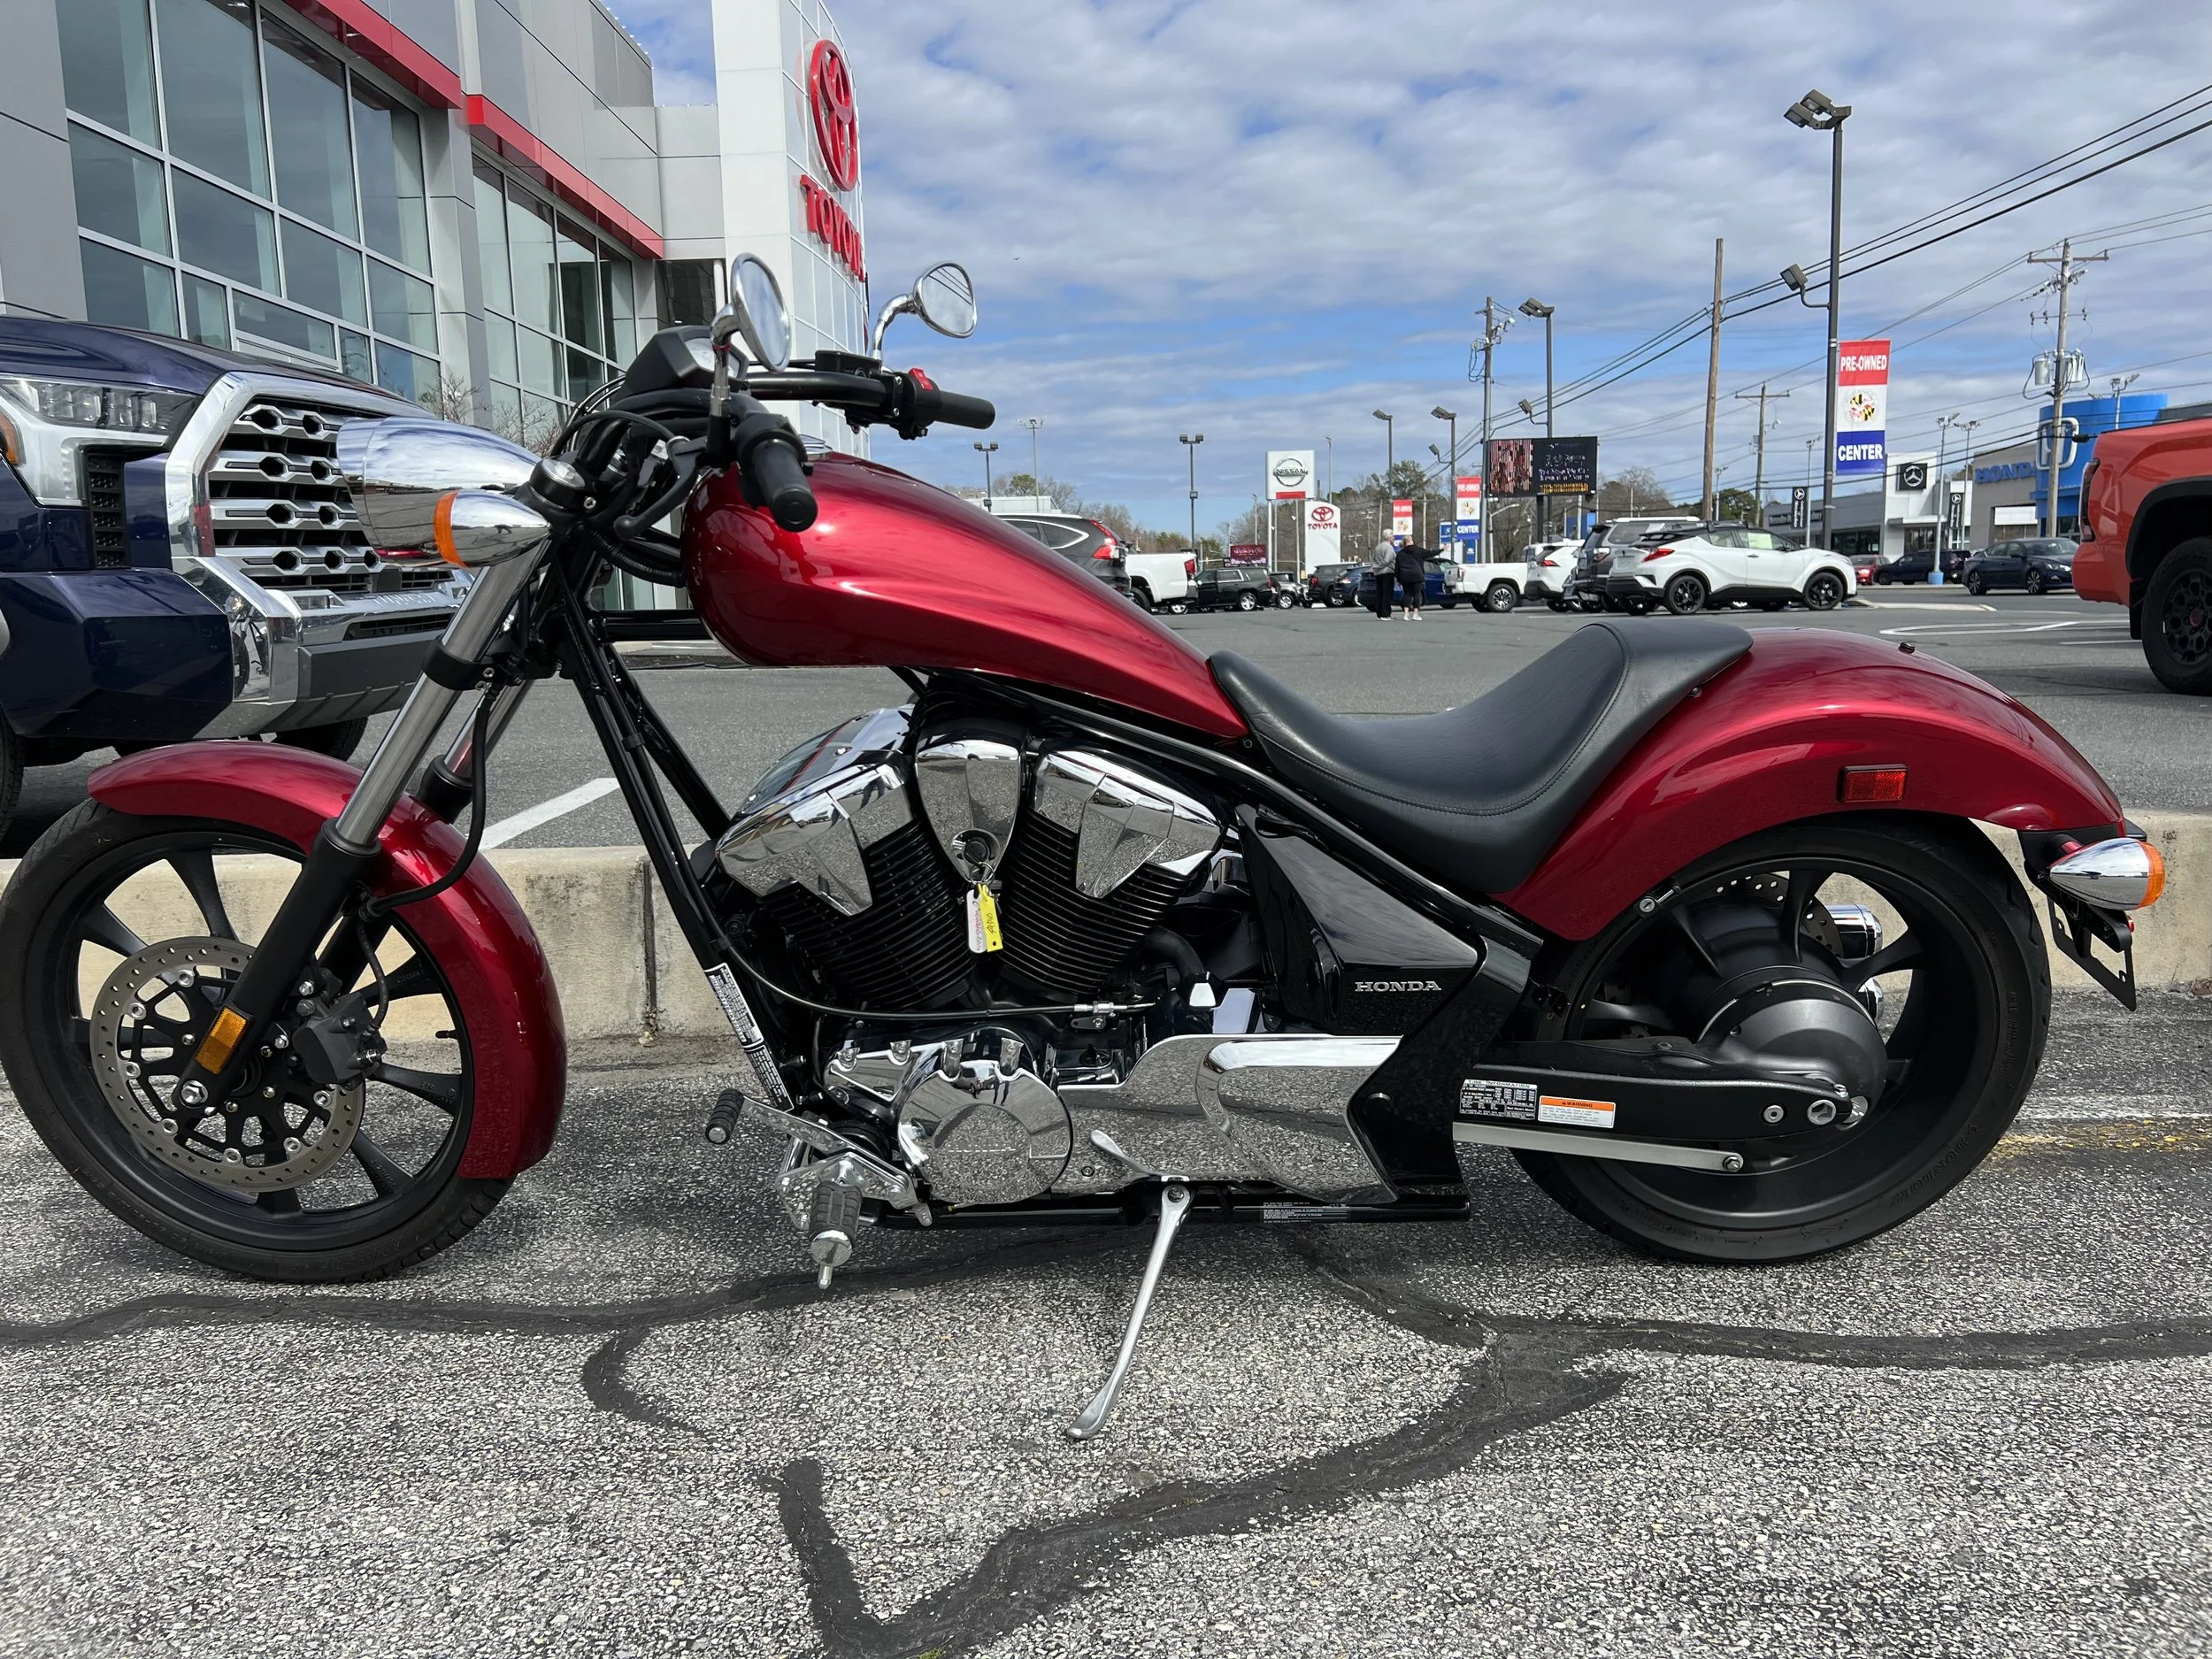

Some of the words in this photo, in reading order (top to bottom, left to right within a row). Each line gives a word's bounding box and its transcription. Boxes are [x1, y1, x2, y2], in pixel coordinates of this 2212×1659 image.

[1840, 354, 1887, 372] PRE-OWNED
[1838, 443, 1884, 461] CENTER
[1456, 525, 1479, 534] CENTER
[1355, 980, 1442, 992] HONDA
